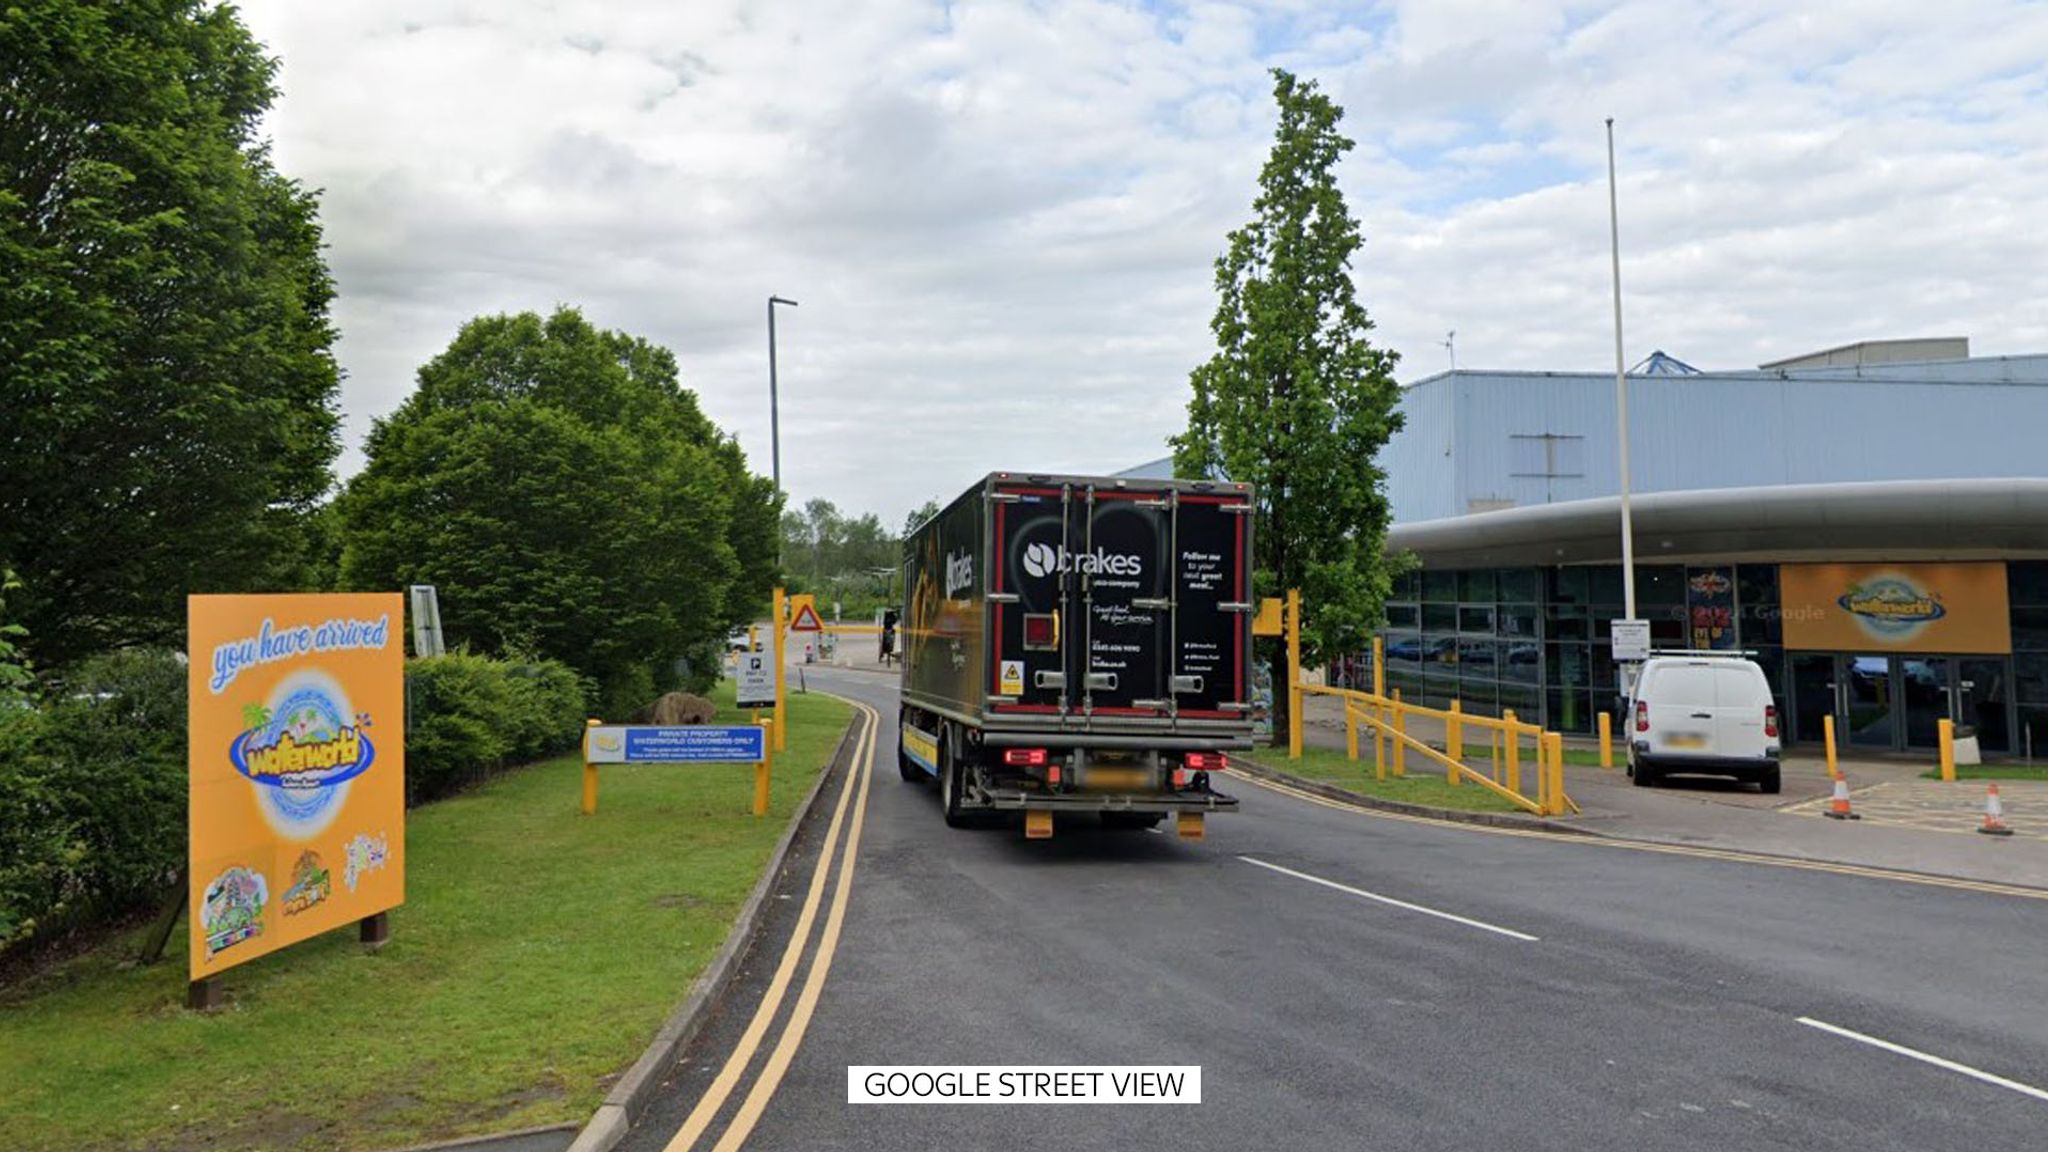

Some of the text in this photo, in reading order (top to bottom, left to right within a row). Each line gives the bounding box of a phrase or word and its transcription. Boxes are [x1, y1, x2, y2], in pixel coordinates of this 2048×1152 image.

[1057, 545, 1142, 576] brakes
[1201, 573, 1222, 581] great
[209, 613, 389, 694] you have arrived
[246, 724, 361, 778] waterworld
